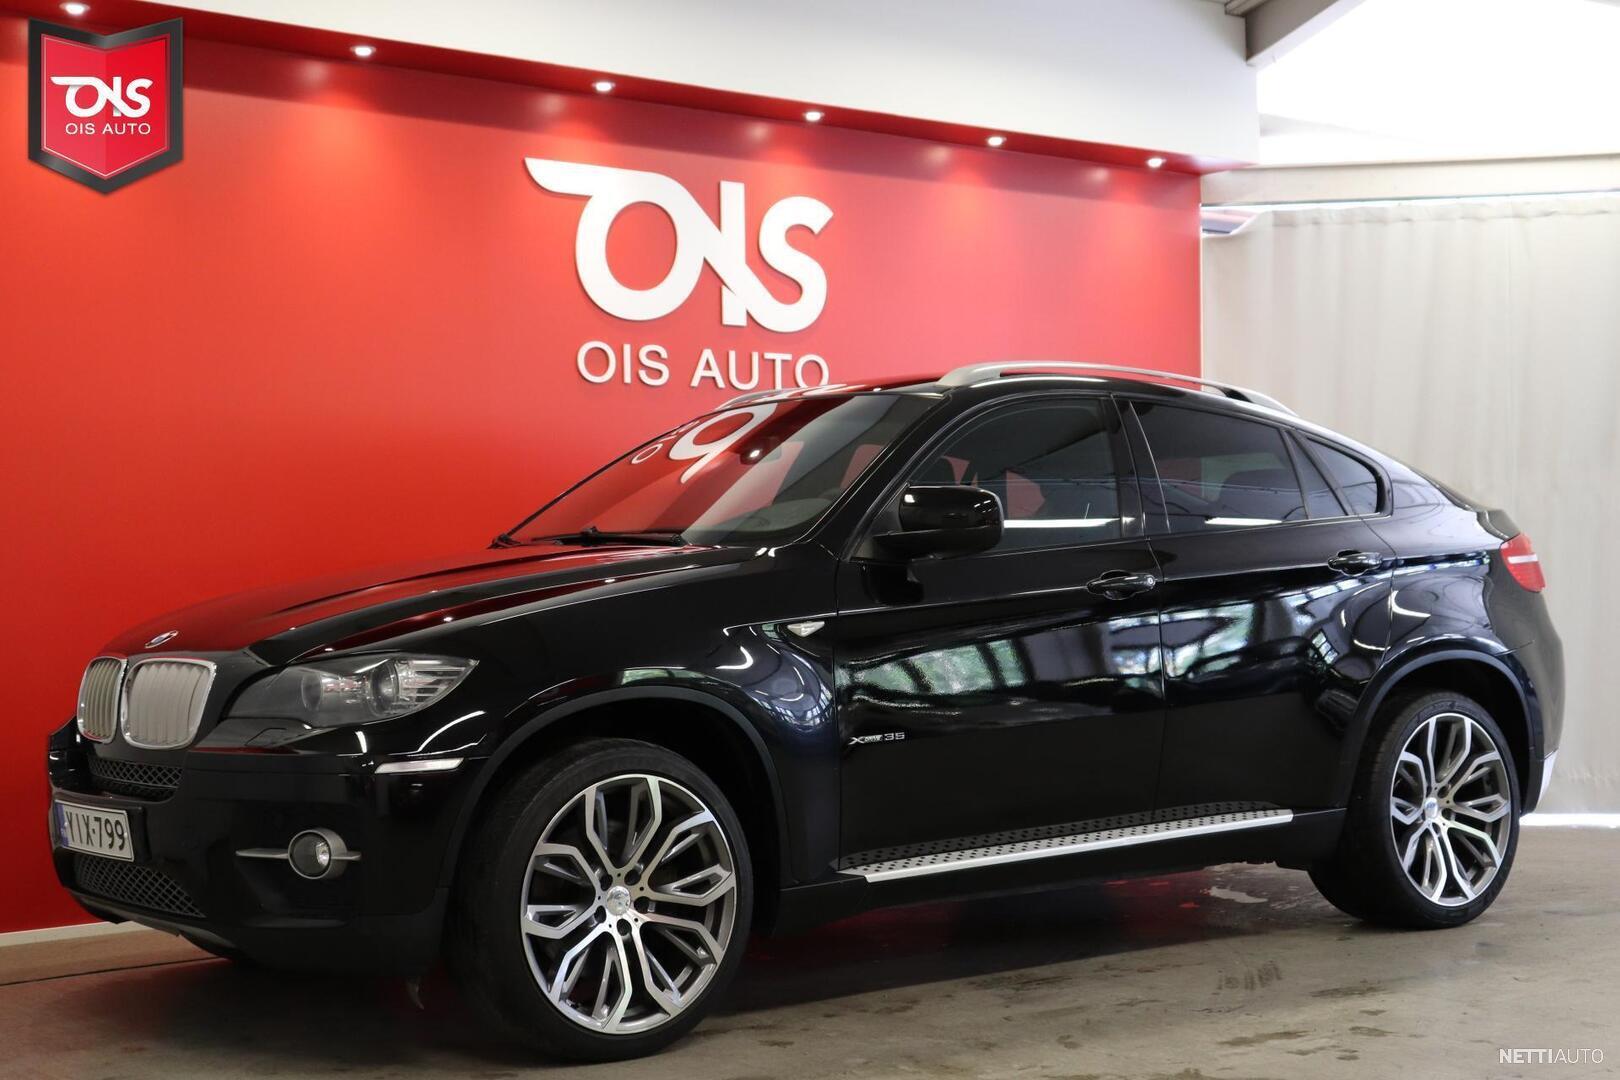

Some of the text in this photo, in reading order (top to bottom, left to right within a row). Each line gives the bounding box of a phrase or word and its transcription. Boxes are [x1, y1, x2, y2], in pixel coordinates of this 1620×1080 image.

[524, 157, 834, 333] OIS
[576, 340, 830, 391] OIS AUTO
[65, 811, 126, 851] YIX-799
